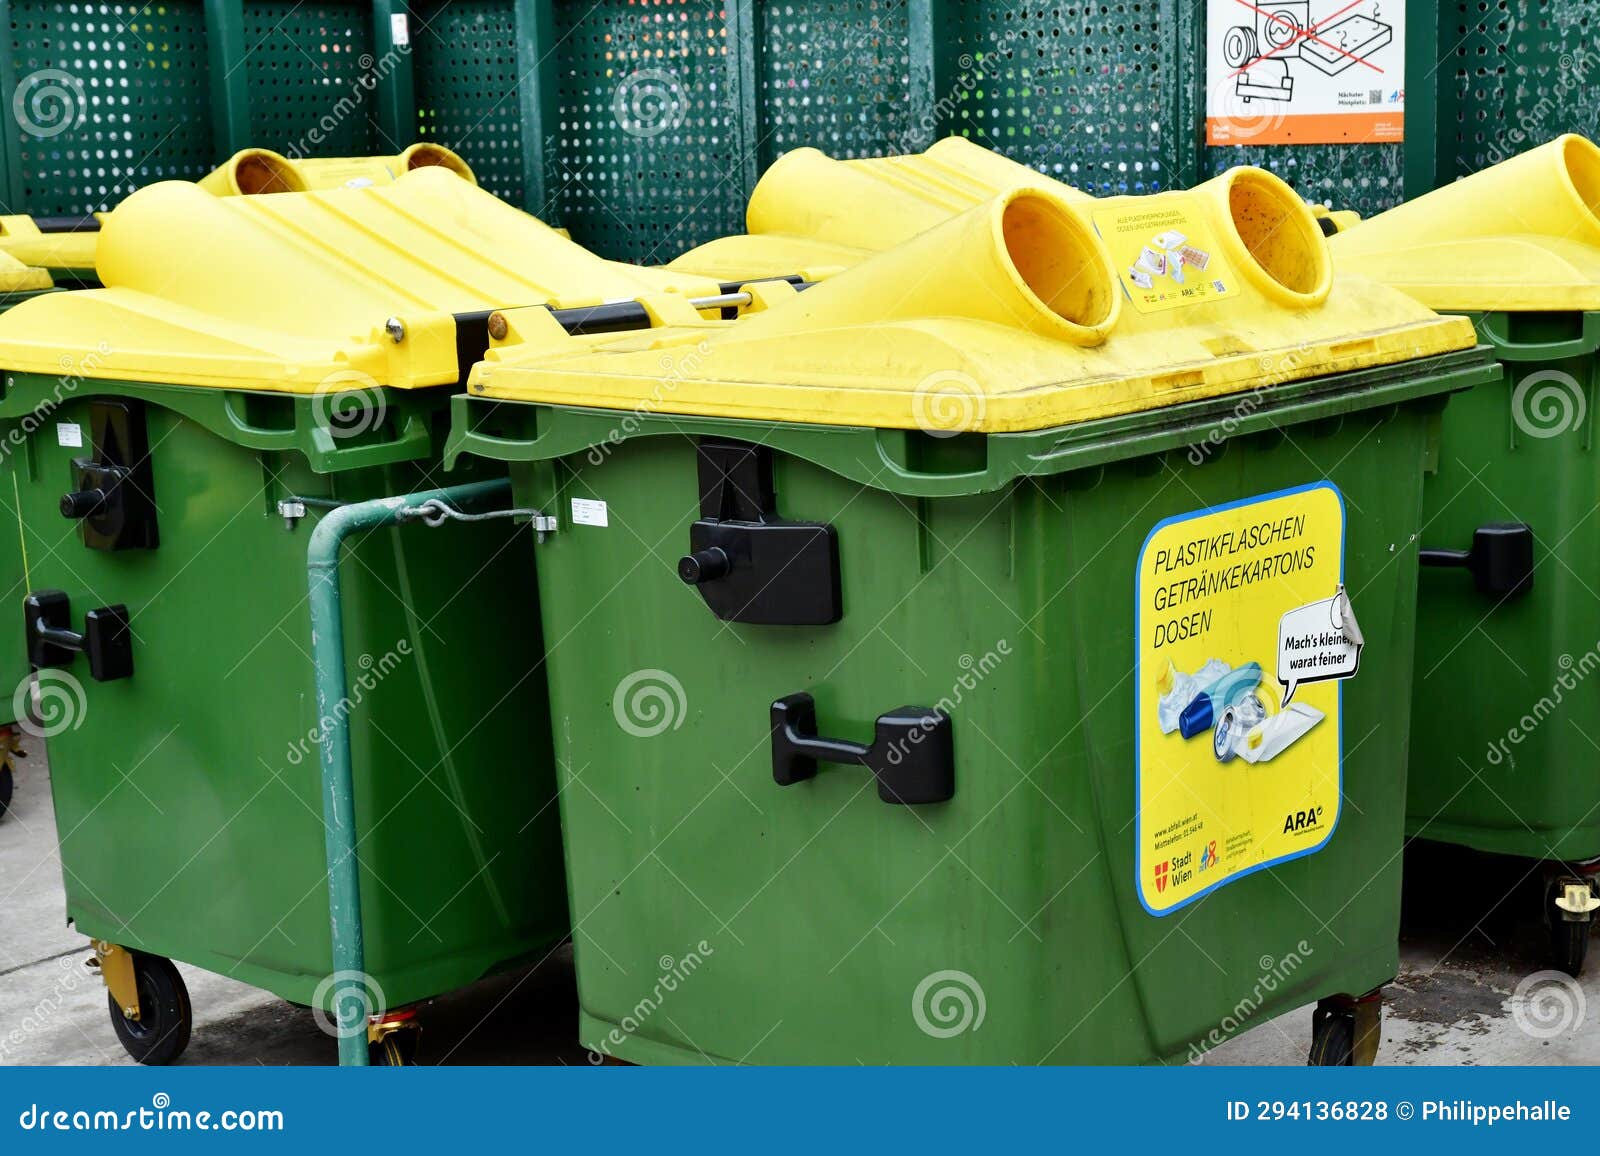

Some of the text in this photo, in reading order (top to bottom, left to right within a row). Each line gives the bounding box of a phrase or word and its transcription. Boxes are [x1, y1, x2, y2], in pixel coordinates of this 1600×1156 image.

[1154, 514, 1306, 575] PLASTIKFLASCHEN
[1154, 546, 1315, 611] GETRÄNKEKARTONS
[1154, 608, 1213, 649] DOSEN
[1285, 634, 1318, 651] Mach's
[1289, 651, 1347, 670] warat feiner
[1283, 807, 1317, 834] ARA
[1171, 850, 1192, 872] Stadt
[1171, 869, 1192, 887] Wien
